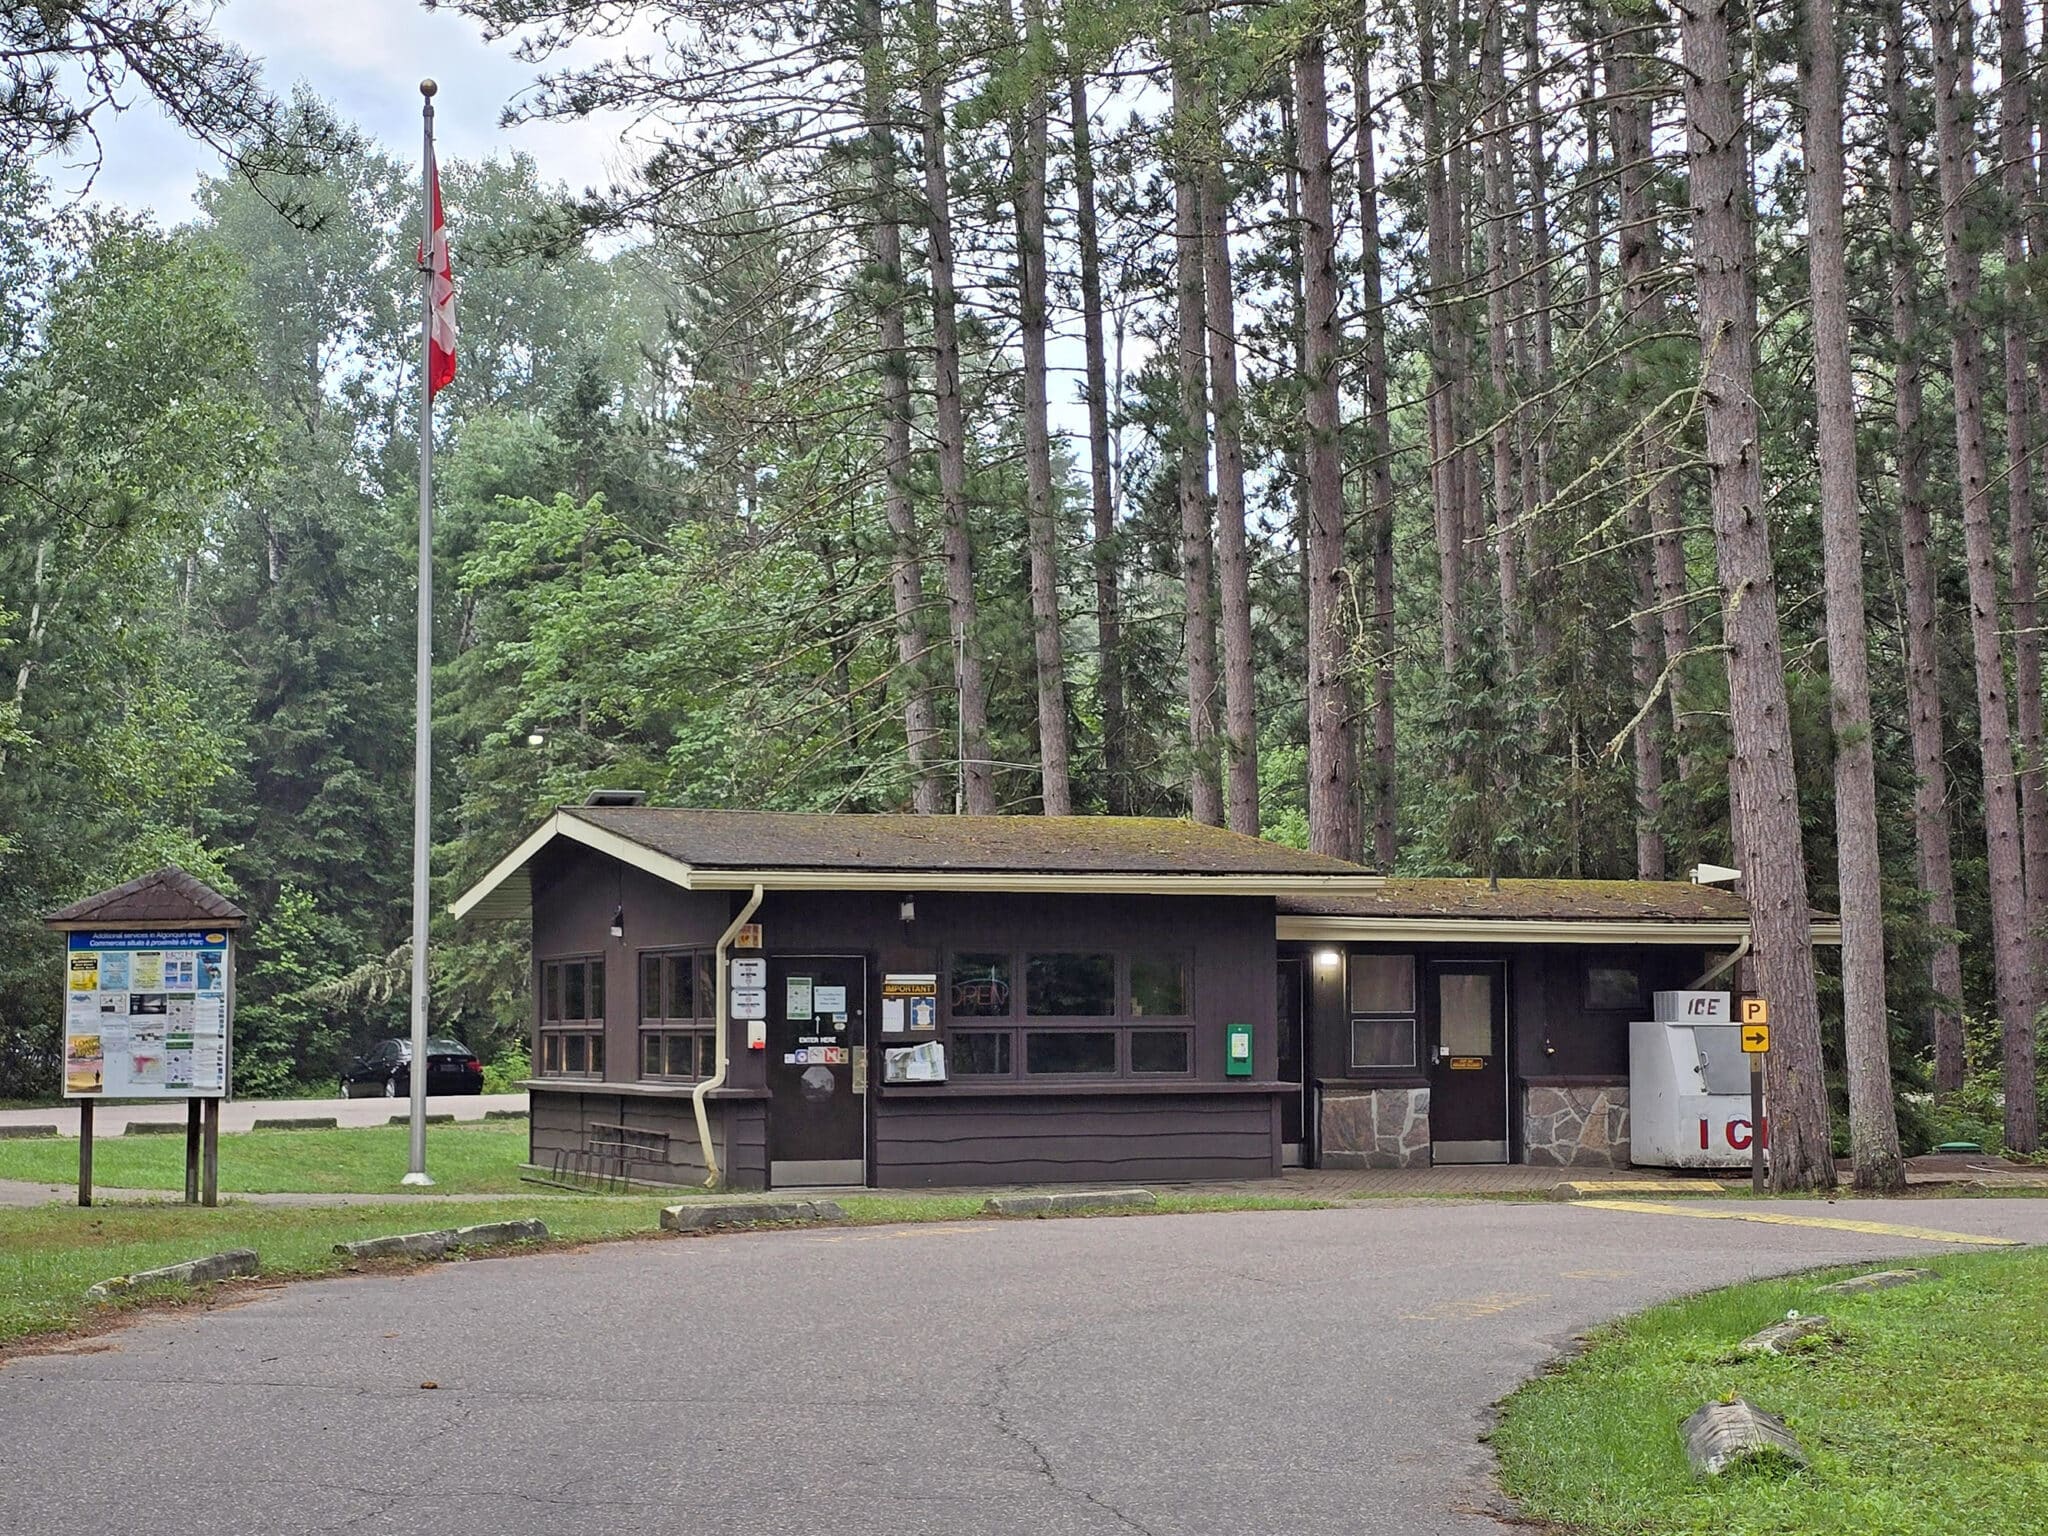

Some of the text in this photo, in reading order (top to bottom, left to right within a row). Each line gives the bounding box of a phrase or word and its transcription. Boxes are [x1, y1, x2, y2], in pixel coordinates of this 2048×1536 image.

[885, 985, 932, 993] IMPORTANT
[1687, 998, 1721, 1016] ICE
[1748, 1003, 1761, 1020] P
